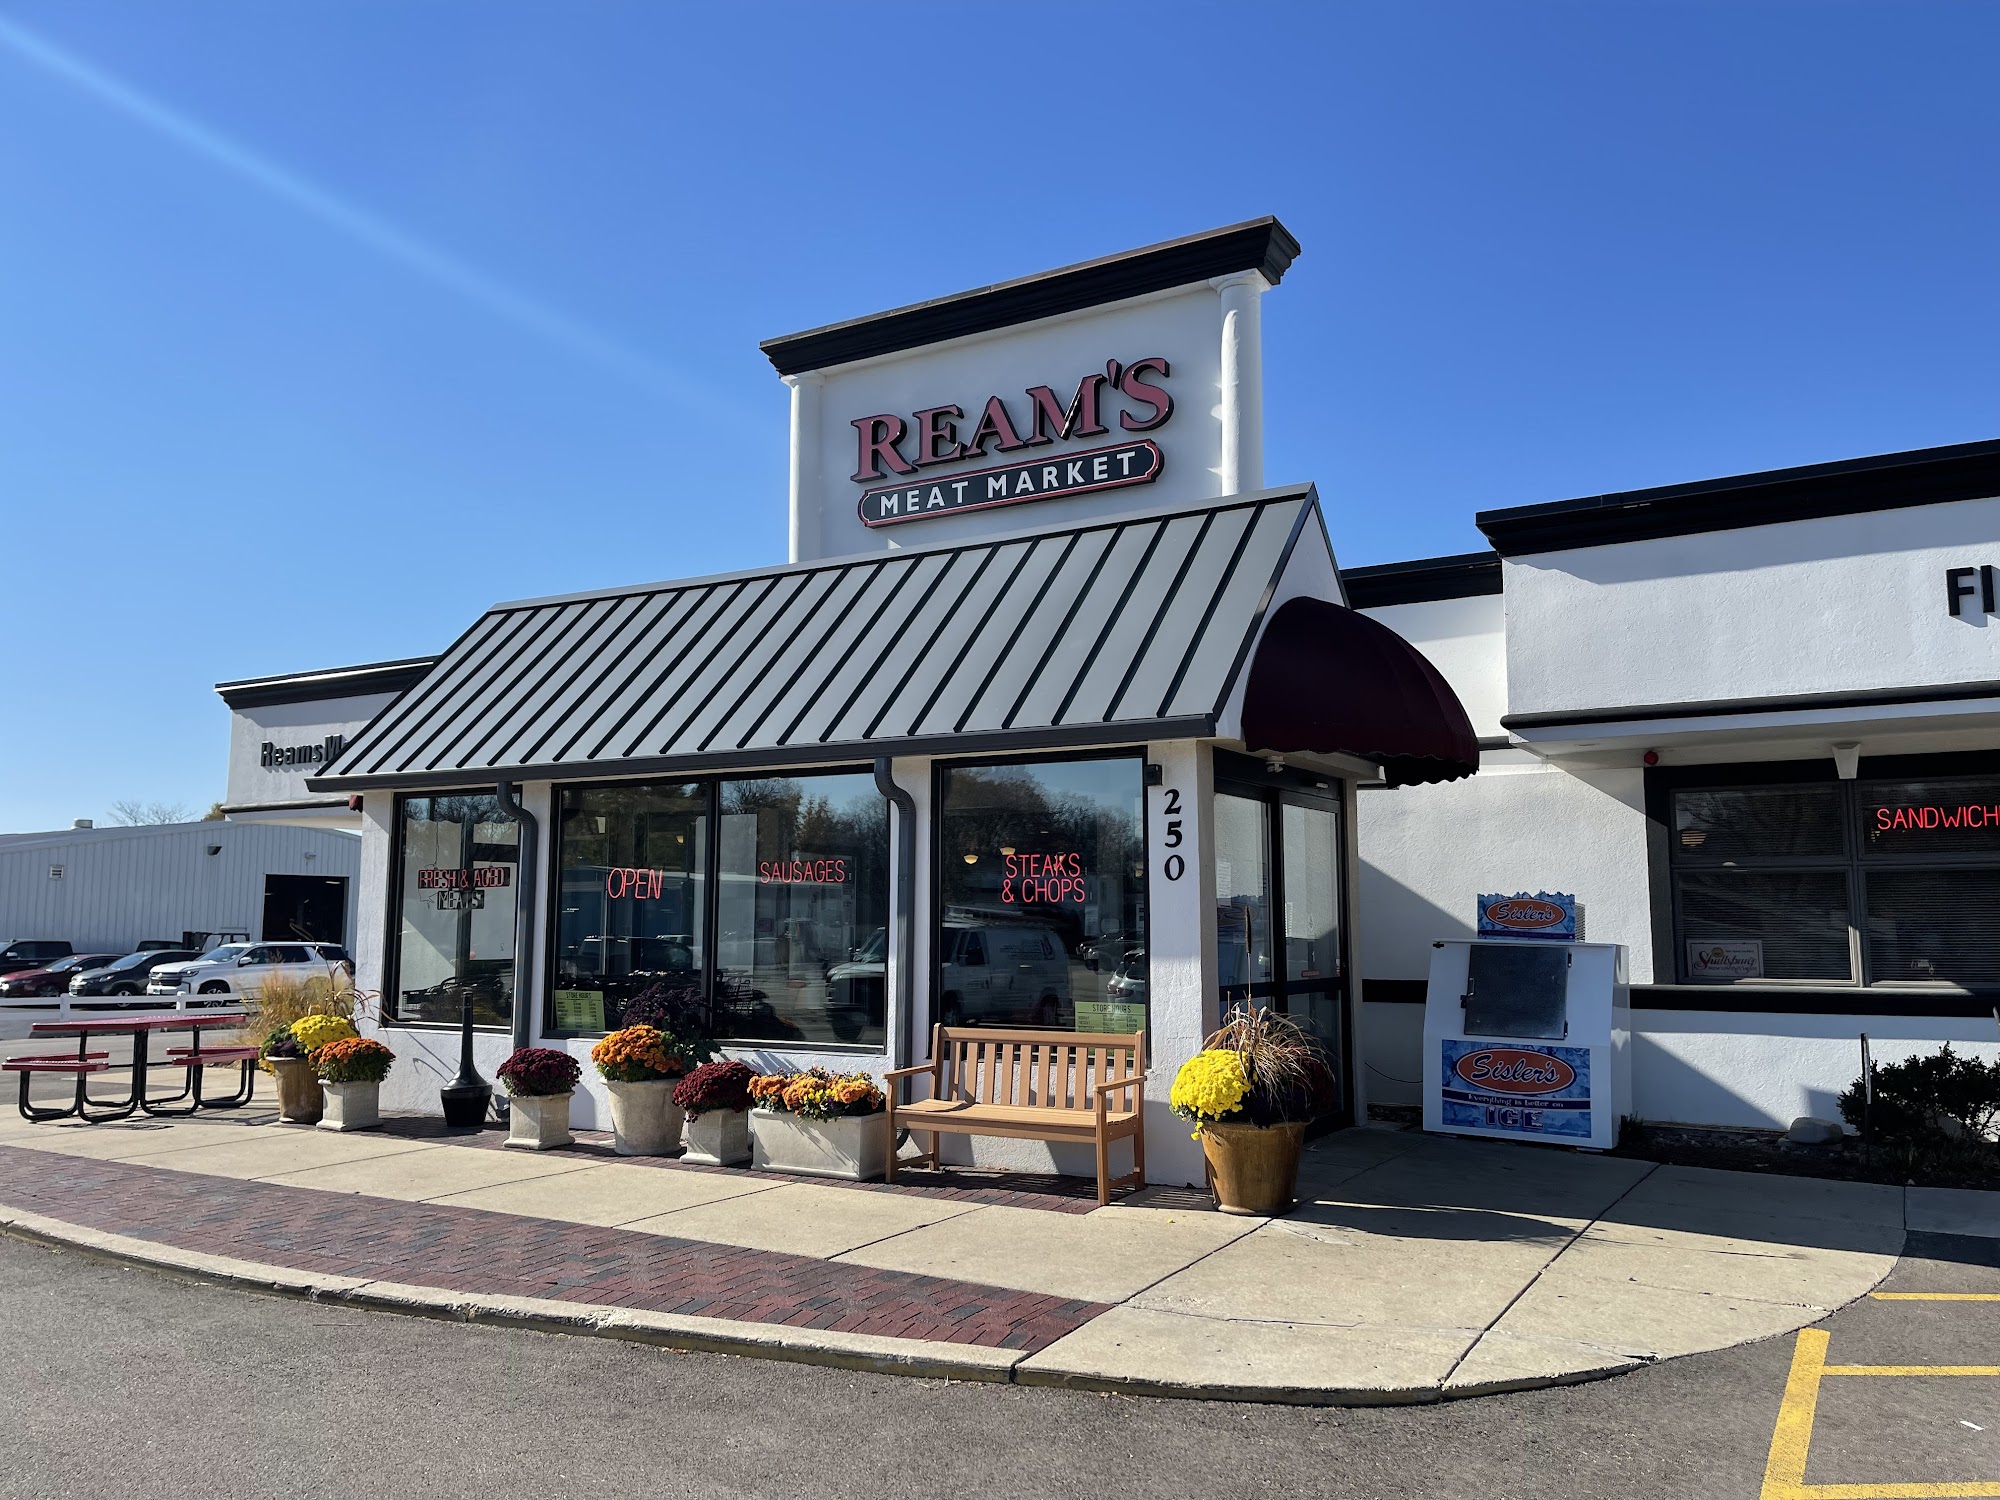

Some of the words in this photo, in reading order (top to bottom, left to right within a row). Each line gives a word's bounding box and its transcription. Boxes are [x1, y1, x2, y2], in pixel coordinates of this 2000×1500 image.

[850, 357, 1174, 483] REAM'S
[879, 480, 969, 517] MEAT
[986, 451, 1136, 499] MARKET
[260, 734, 351, 767] ReamsM
[1876, 804, 2000, 830] SANDWICH
[1163, 788, 1185, 881] 250
[419, 869, 458, 888] FRESH
[460, 869, 469, 888] &
[473, 867, 505, 888] AGED
[759, 859, 846, 884] SAUSAGES
[1005, 853, 1081, 879] STEAKS
[607, 867, 663, 899] OPEN
[1001, 878, 1015, 903] &
[1021, 877, 1086, 903] CHOPS
[1496, 902, 1556, 922] Sisler's
[1471, 1053, 1560, 1085] Sisler's
[1524, 1099, 1549, 1107] better
[1486, 1106, 1544, 1130] ICE
